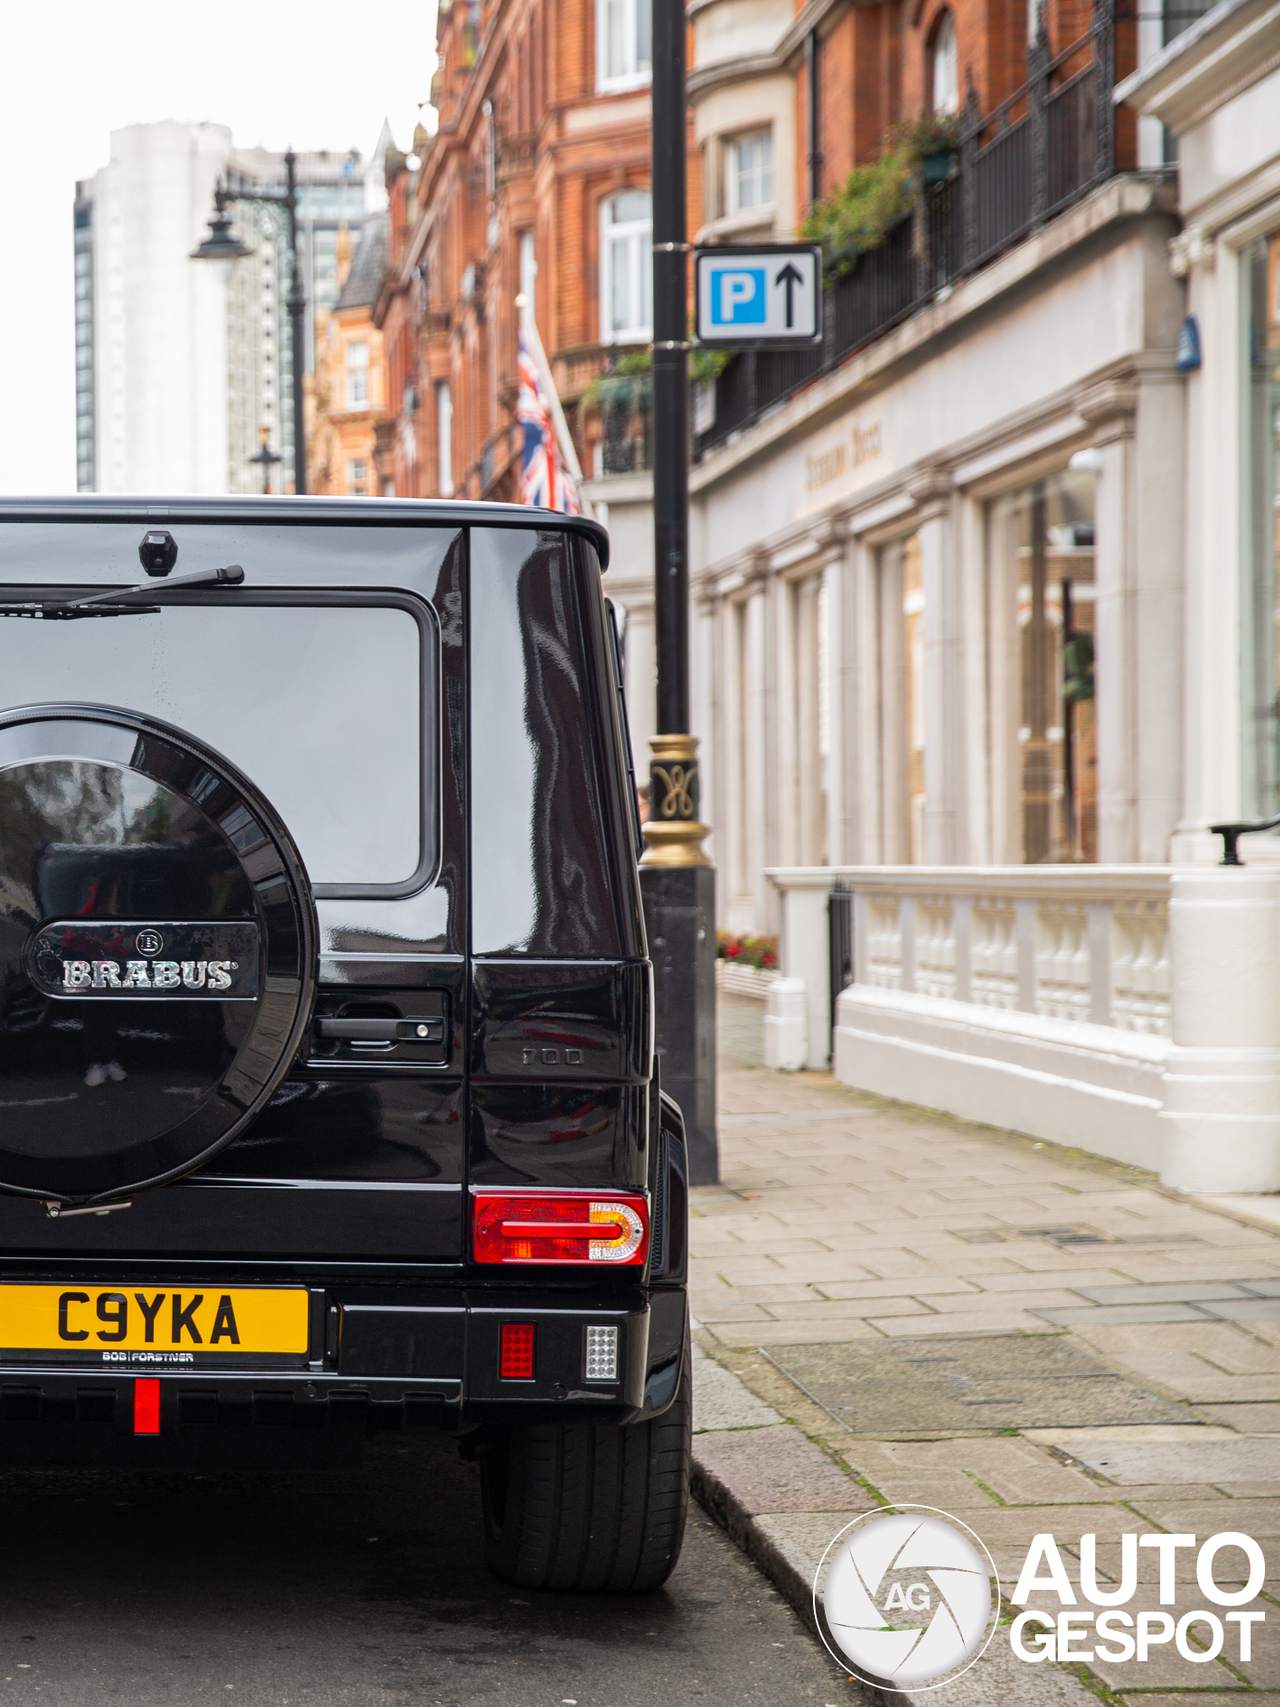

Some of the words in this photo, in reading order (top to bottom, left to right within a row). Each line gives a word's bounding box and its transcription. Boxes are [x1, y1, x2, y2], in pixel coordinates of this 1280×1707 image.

[721, 271, 757, 322] P
[523, 1048, 584, 1065] 700
[58, 1291, 241, 1345] C9YKA
